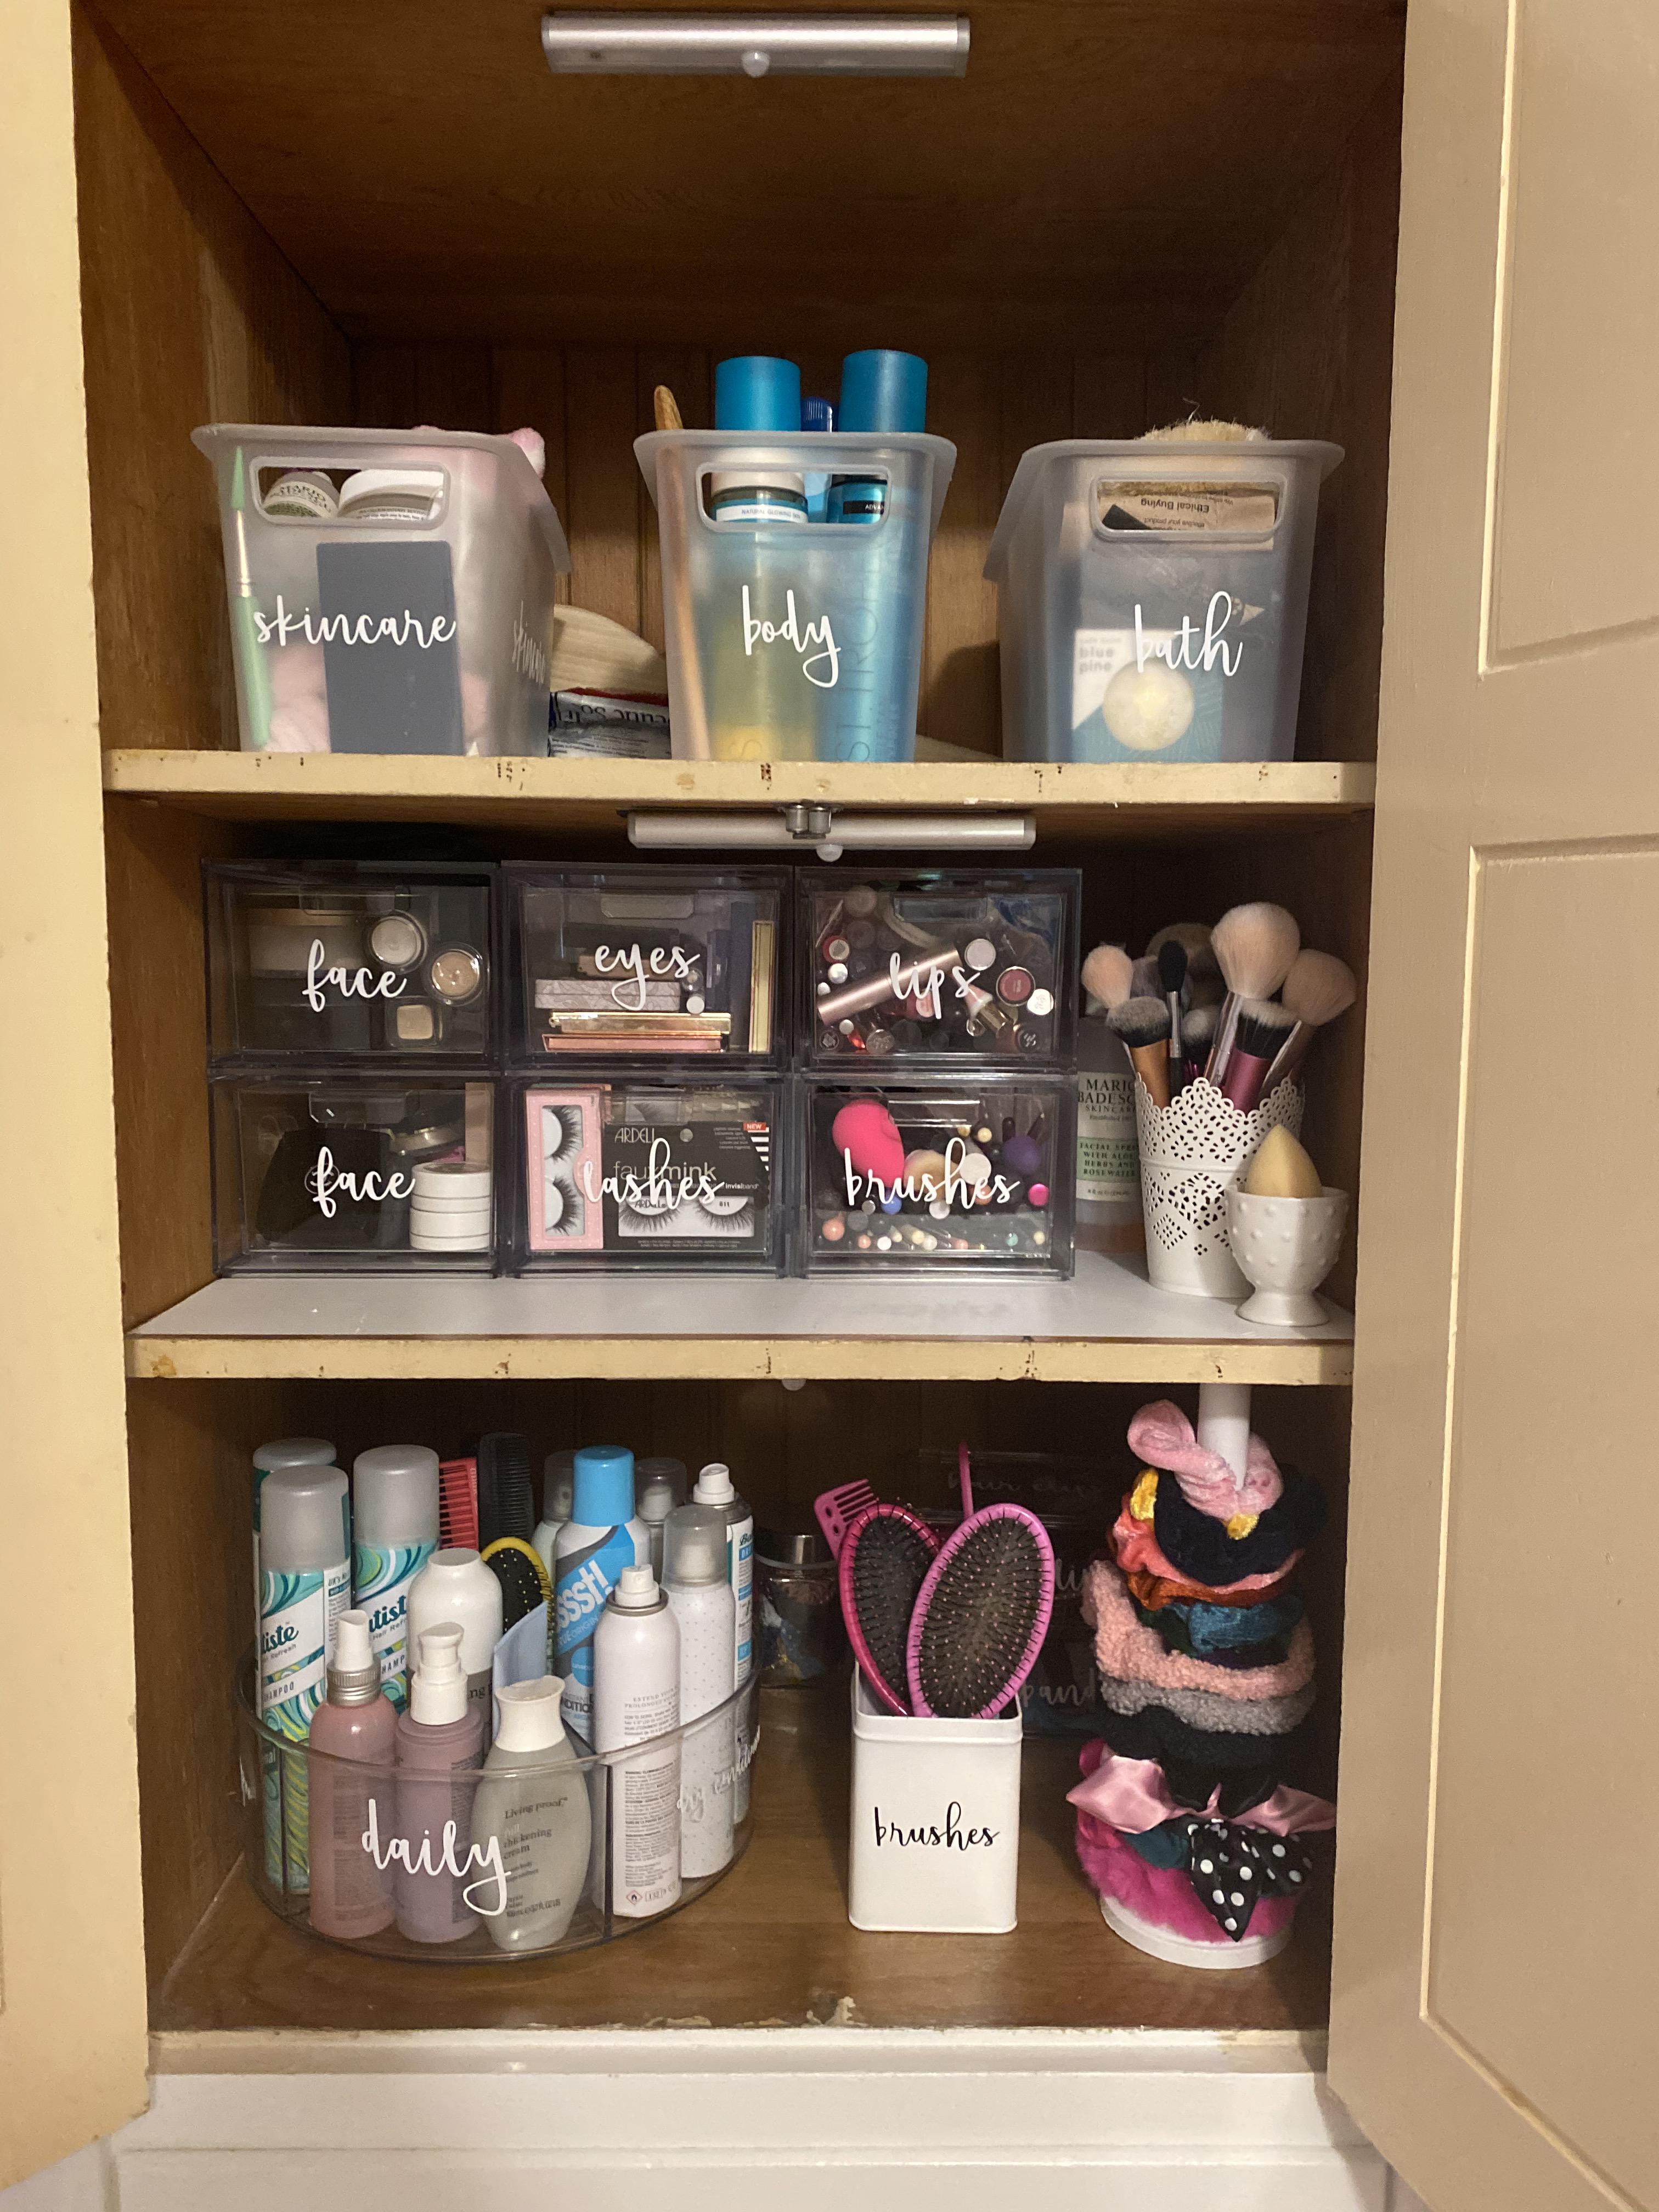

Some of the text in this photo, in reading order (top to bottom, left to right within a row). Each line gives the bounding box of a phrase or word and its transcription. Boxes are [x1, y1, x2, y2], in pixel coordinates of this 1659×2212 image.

[1141, 498, 1210, 513] Ethical Buying
[253, 595, 456, 649] skincare
[742, 585, 842, 688] body
[1134, 590, 1243, 677] bath
[1079, 646, 1114, 658] blue
[1079, 661, 1113, 675] pine
[302, 939, 408, 1013] face
[595, 943, 701, 1011] eyes
[889, 952, 981, 1020] lips
[313, 1146, 415, 1218] face
[583, 1137, 725, 1209] lashes
[661, 1161, 717, 1181] mink
[844, 1137, 1021, 1209] brushes
[381, 1654, 405, 1674] HAMP
[503, 1829, 552, 1848] thickening
[505, 1805, 533, 1820] Living
[874, 1801, 999, 1851] brushes
[362, 1798, 512, 1916] daily
[503, 1844, 530, 1860] cream
